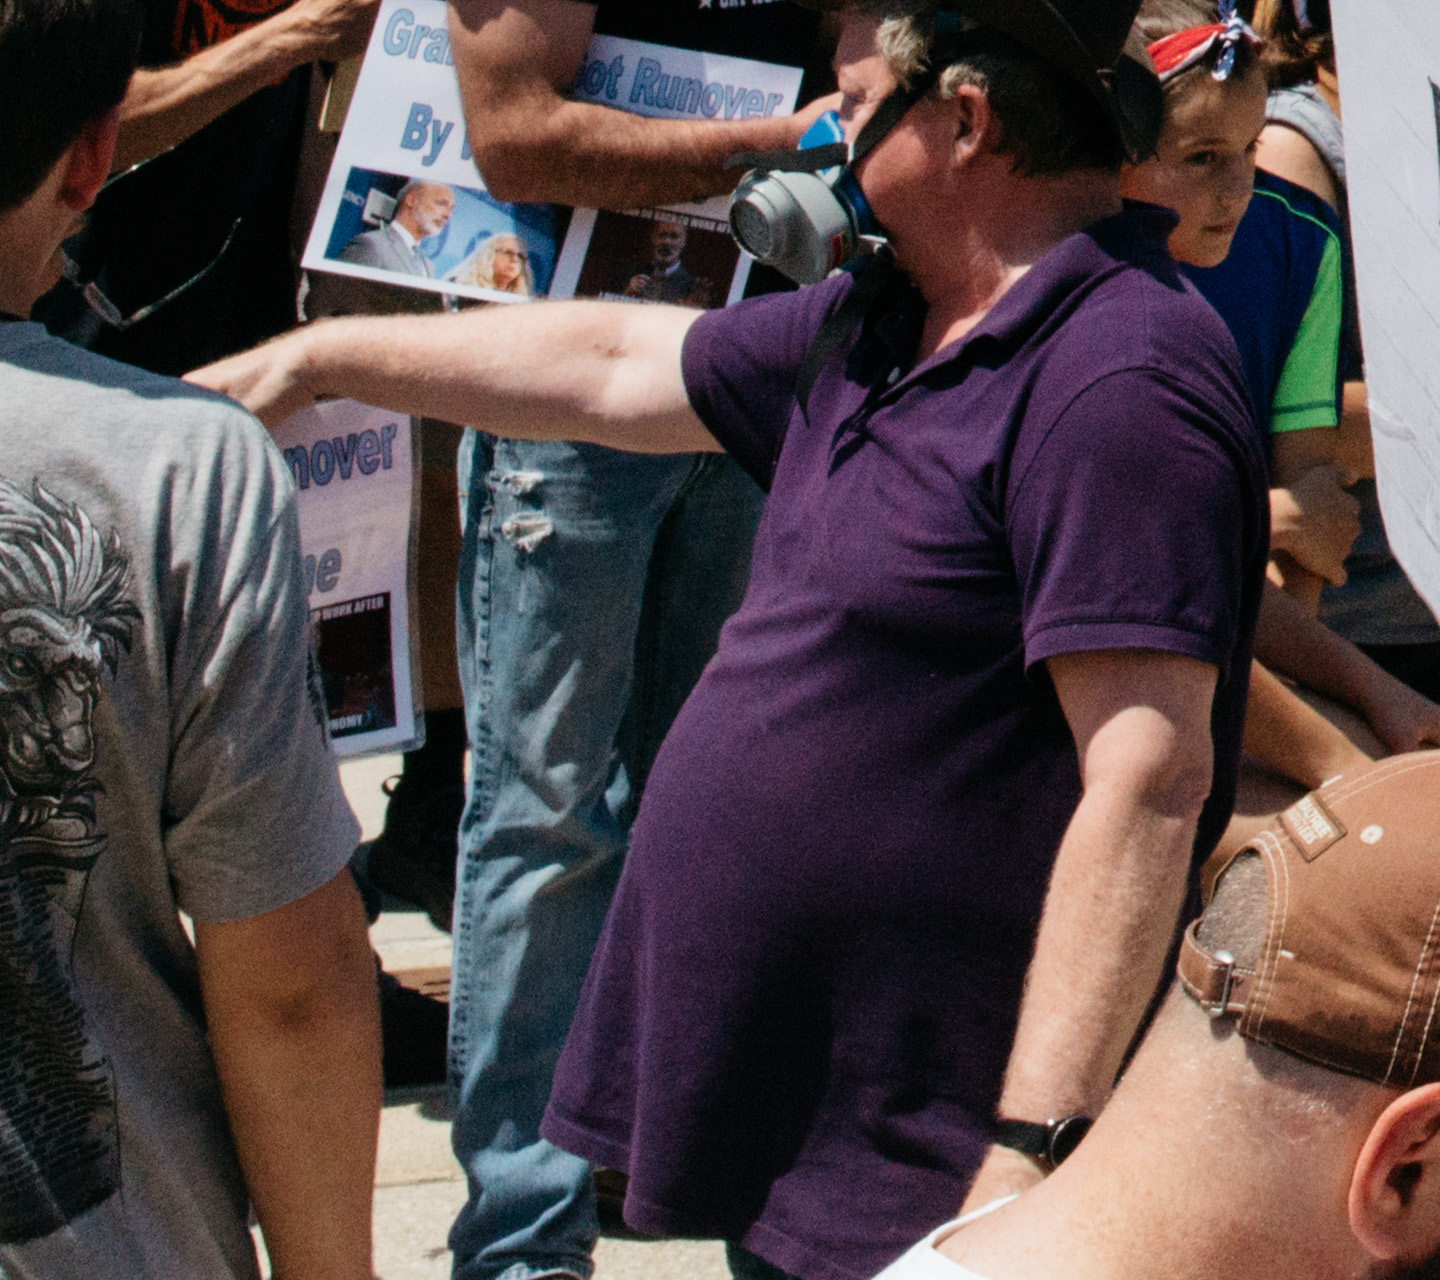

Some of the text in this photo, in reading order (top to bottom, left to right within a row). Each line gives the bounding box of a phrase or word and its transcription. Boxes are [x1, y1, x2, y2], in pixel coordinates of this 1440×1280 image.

[383, 8, 784, 121] Gra ot Runover
[400, 102, 456, 167] By
[352, 595, 386, 617] AFTER
